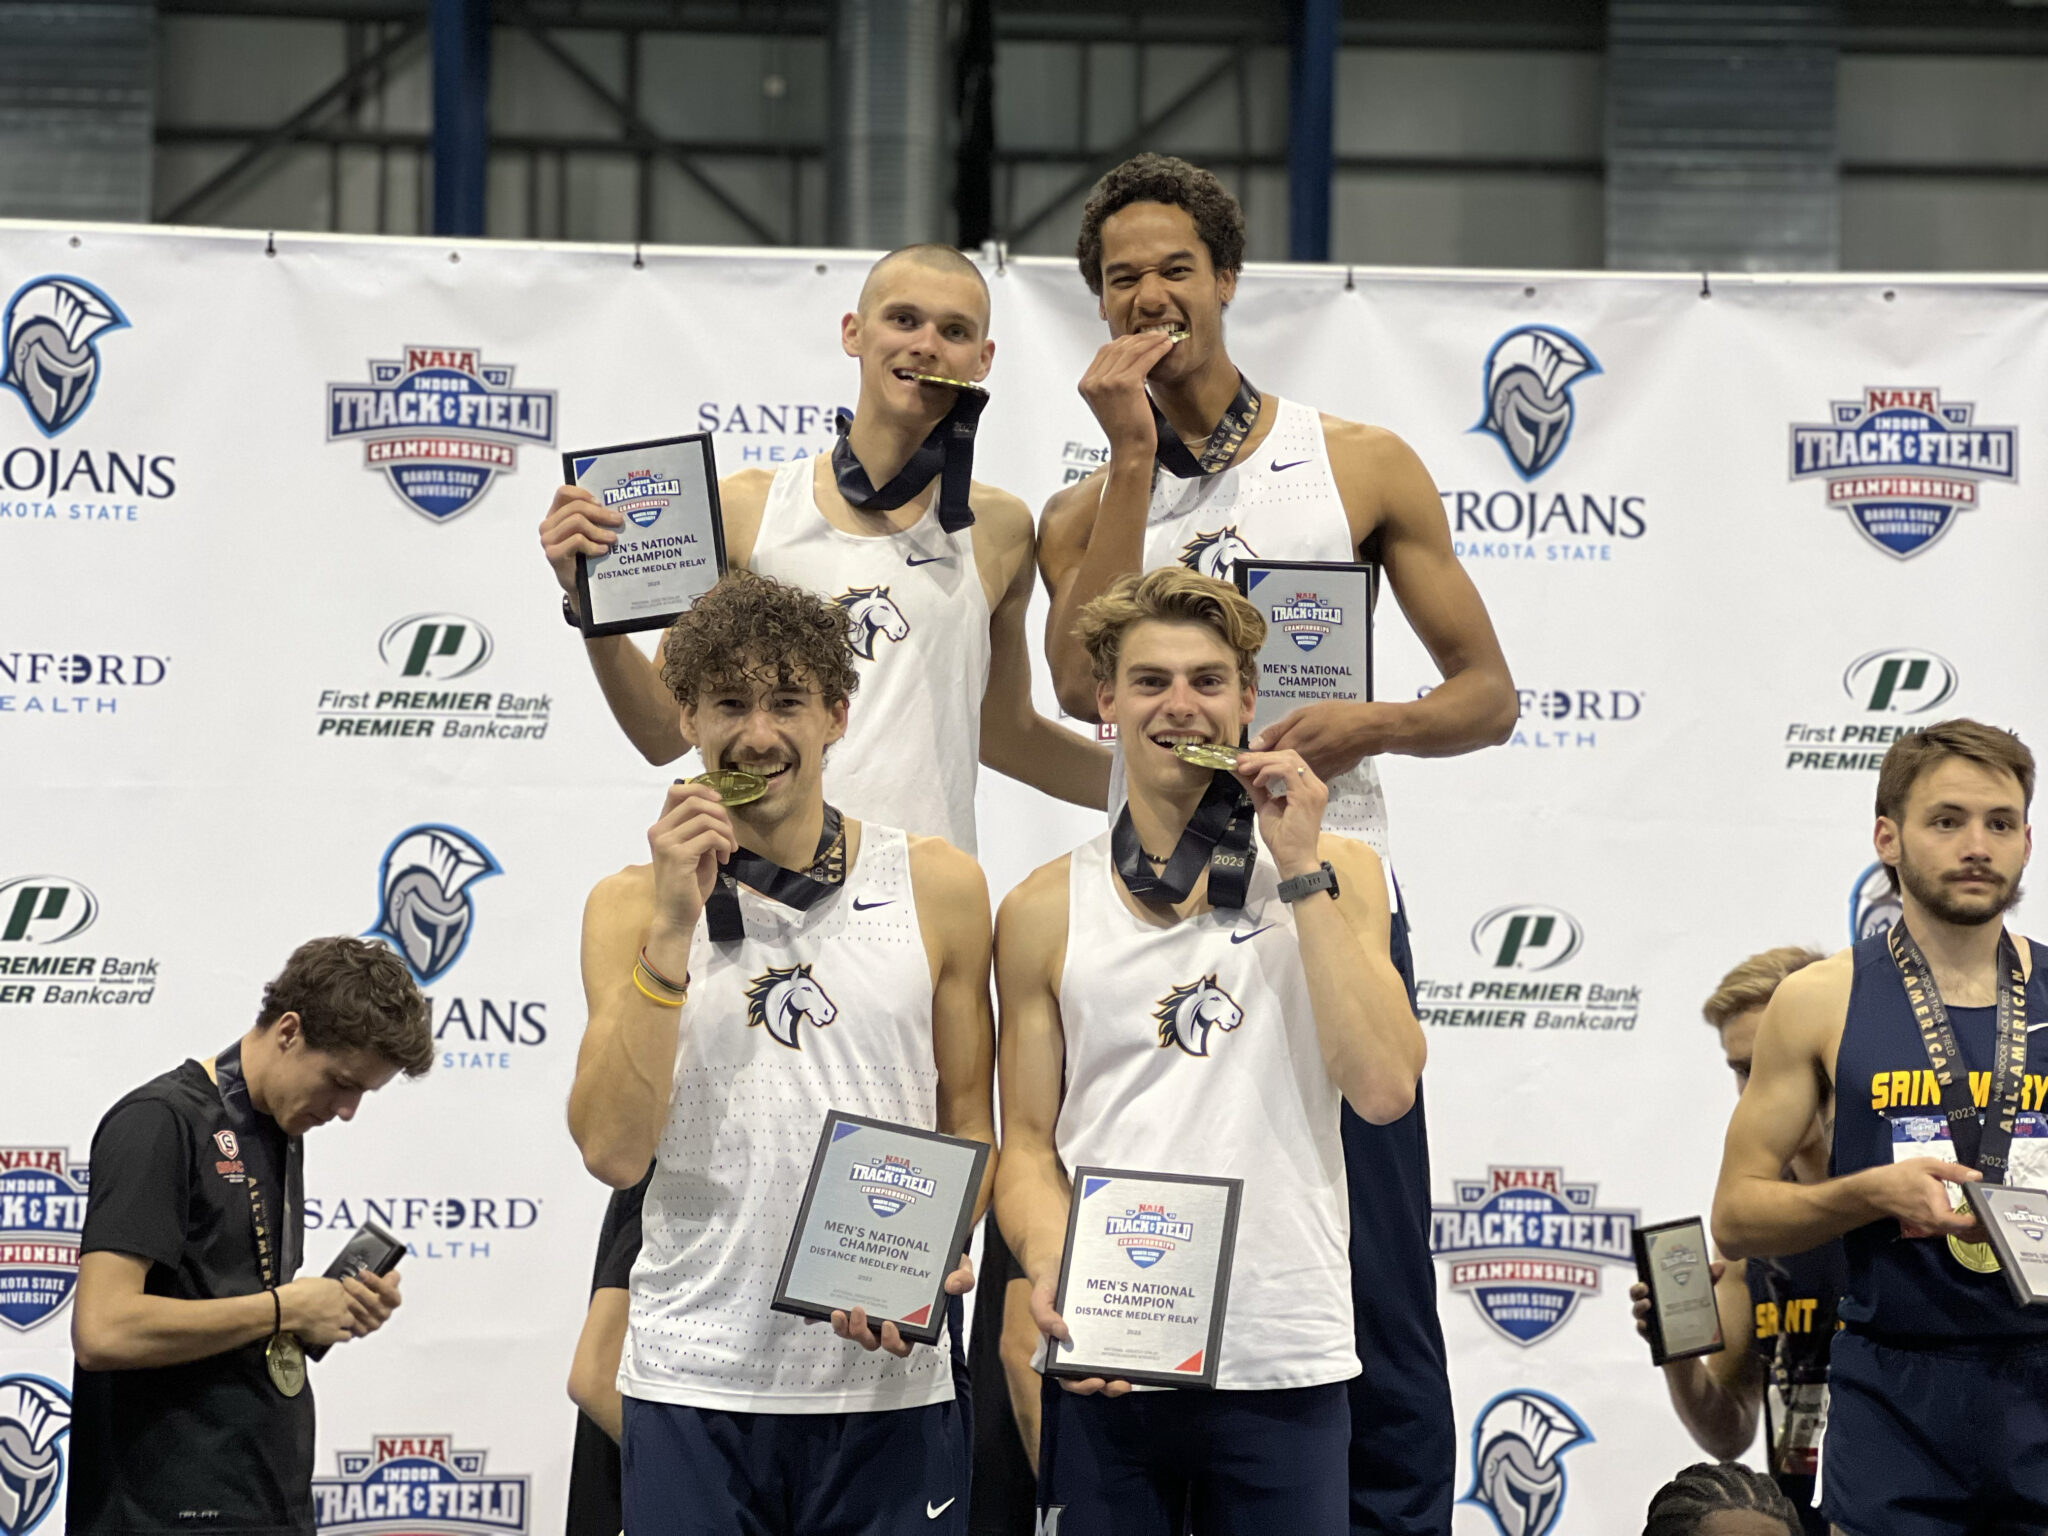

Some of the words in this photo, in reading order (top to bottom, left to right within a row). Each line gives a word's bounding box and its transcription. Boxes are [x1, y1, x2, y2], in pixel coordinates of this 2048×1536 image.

[408, 349, 476, 376] NAIA
[414, 377, 469, 393] INDOOR
[1869, 391, 1936, 415] NAIA
[699, 402, 854, 434] SANFO
[1875, 417, 1930, 431] INDOOR
[371, 441, 511, 464] CHAMPIONSHIPS
[1063, 442, 1109, 462] First
[0, 447, 176, 499] OJANS
[407, 485, 474, 500] UNIVERSITY
[1833, 481, 1972, 501] CHAMPIONSHIPS
[69, 504, 139, 521] STATE
[1869, 522, 1936, 536] UNIVERSITY
[641, 533, 698, 550] NATIONAL
[619, 547, 682, 565] CHAMPION
[1454, 542, 1536, 559] DAKOTA
[1547, 545, 1612, 561] STATE
[597, 567, 640, 580] DISTANCE
[642, 562, 677, 574] MEDLEY
[680, 558, 707, 568] RELAY
[1263, 663, 1298, 674] MEN'S
[1300, 665, 1352, 676] NATIONAL
[1278, 676, 1337, 687] CHAMPION
[318, 690, 370, 709] First
[375, 691, 492, 711] PREMIER
[497, 693, 553, 712] Bank
[1257, 689, 1296, 699] DISTANCE
[1298, 690, 1331, 700] MEDLEY
[1333, 692, 1358, 700] RELAY
[317, 718, 435, 737] PREMIER
[442, 719, 549, 740] Bankcard
[1785, 724, 1836, 742] First
[1214, 855, 1245, 867] 2023
[101, 957, 159, 976] Bank
[43, 985, 155, 1004] Bankcard
[1415, 981, 1462, 998] First
[1468, 982, 1582, 1002] PREMIER
[1587, 984, 1641, 1003] Bank
[1418, 1008, 1526, 1027] PREMIER
[1534, 1011, 1638, 1031] Bankcard
[1918, 967, 1936, 999] INDOOR
[1930, 999, 1948, 1025] TRACK
[1942, 1033, 1956, 1057] FIELD
[443, 1052, 510, 1069] STATE
[1998, 1044, 2009, 1080] INDOOR
[1871, 1070, 1941, 1110] SAIN
[1948, 1106, 1977, 1121] 2023
[1980, 1153, 2008, 1168] 2023
[1492, 1170, 1558, 1195] NAIA
[303, 1198, 539, 1230] SANFORD
[1498, 1198, 1553, 1212] INDOOR
[824, 1220, 866, 1238] MEN'S
[868, 1230, 931, 1253] NATIONAL
[839, 1237, 910, 1261] CHAMPION
[809, 1245, 856, 1263] DISTANCE
[859, 1255, 899, 1272] MEDLEY
[900, 1265, 932, 1280] RELAY
[31, 1277, 65, 1292] STATE
[1455, 1264, 1596, 1286] CHAMPIONSHIPS
[1086, 1278, 1129, 1292] MEN'S
[1132, 1283, 1196, 1299] NATIONAL
[1103, 1293, 1175, 1309] CHAMPION
[1075, 1306, 1122, 1319] DISTANCE
[1125, 1310, 1165, 1322] MEDLEY
[1167, 1314, 1199, 1325] RELAY
[1492, 1308, 1558, 1322] UNIVERSITY
[377, 1439, 447, 1464] NAIA
[383, 1468, 440, 1482] INDOOR
